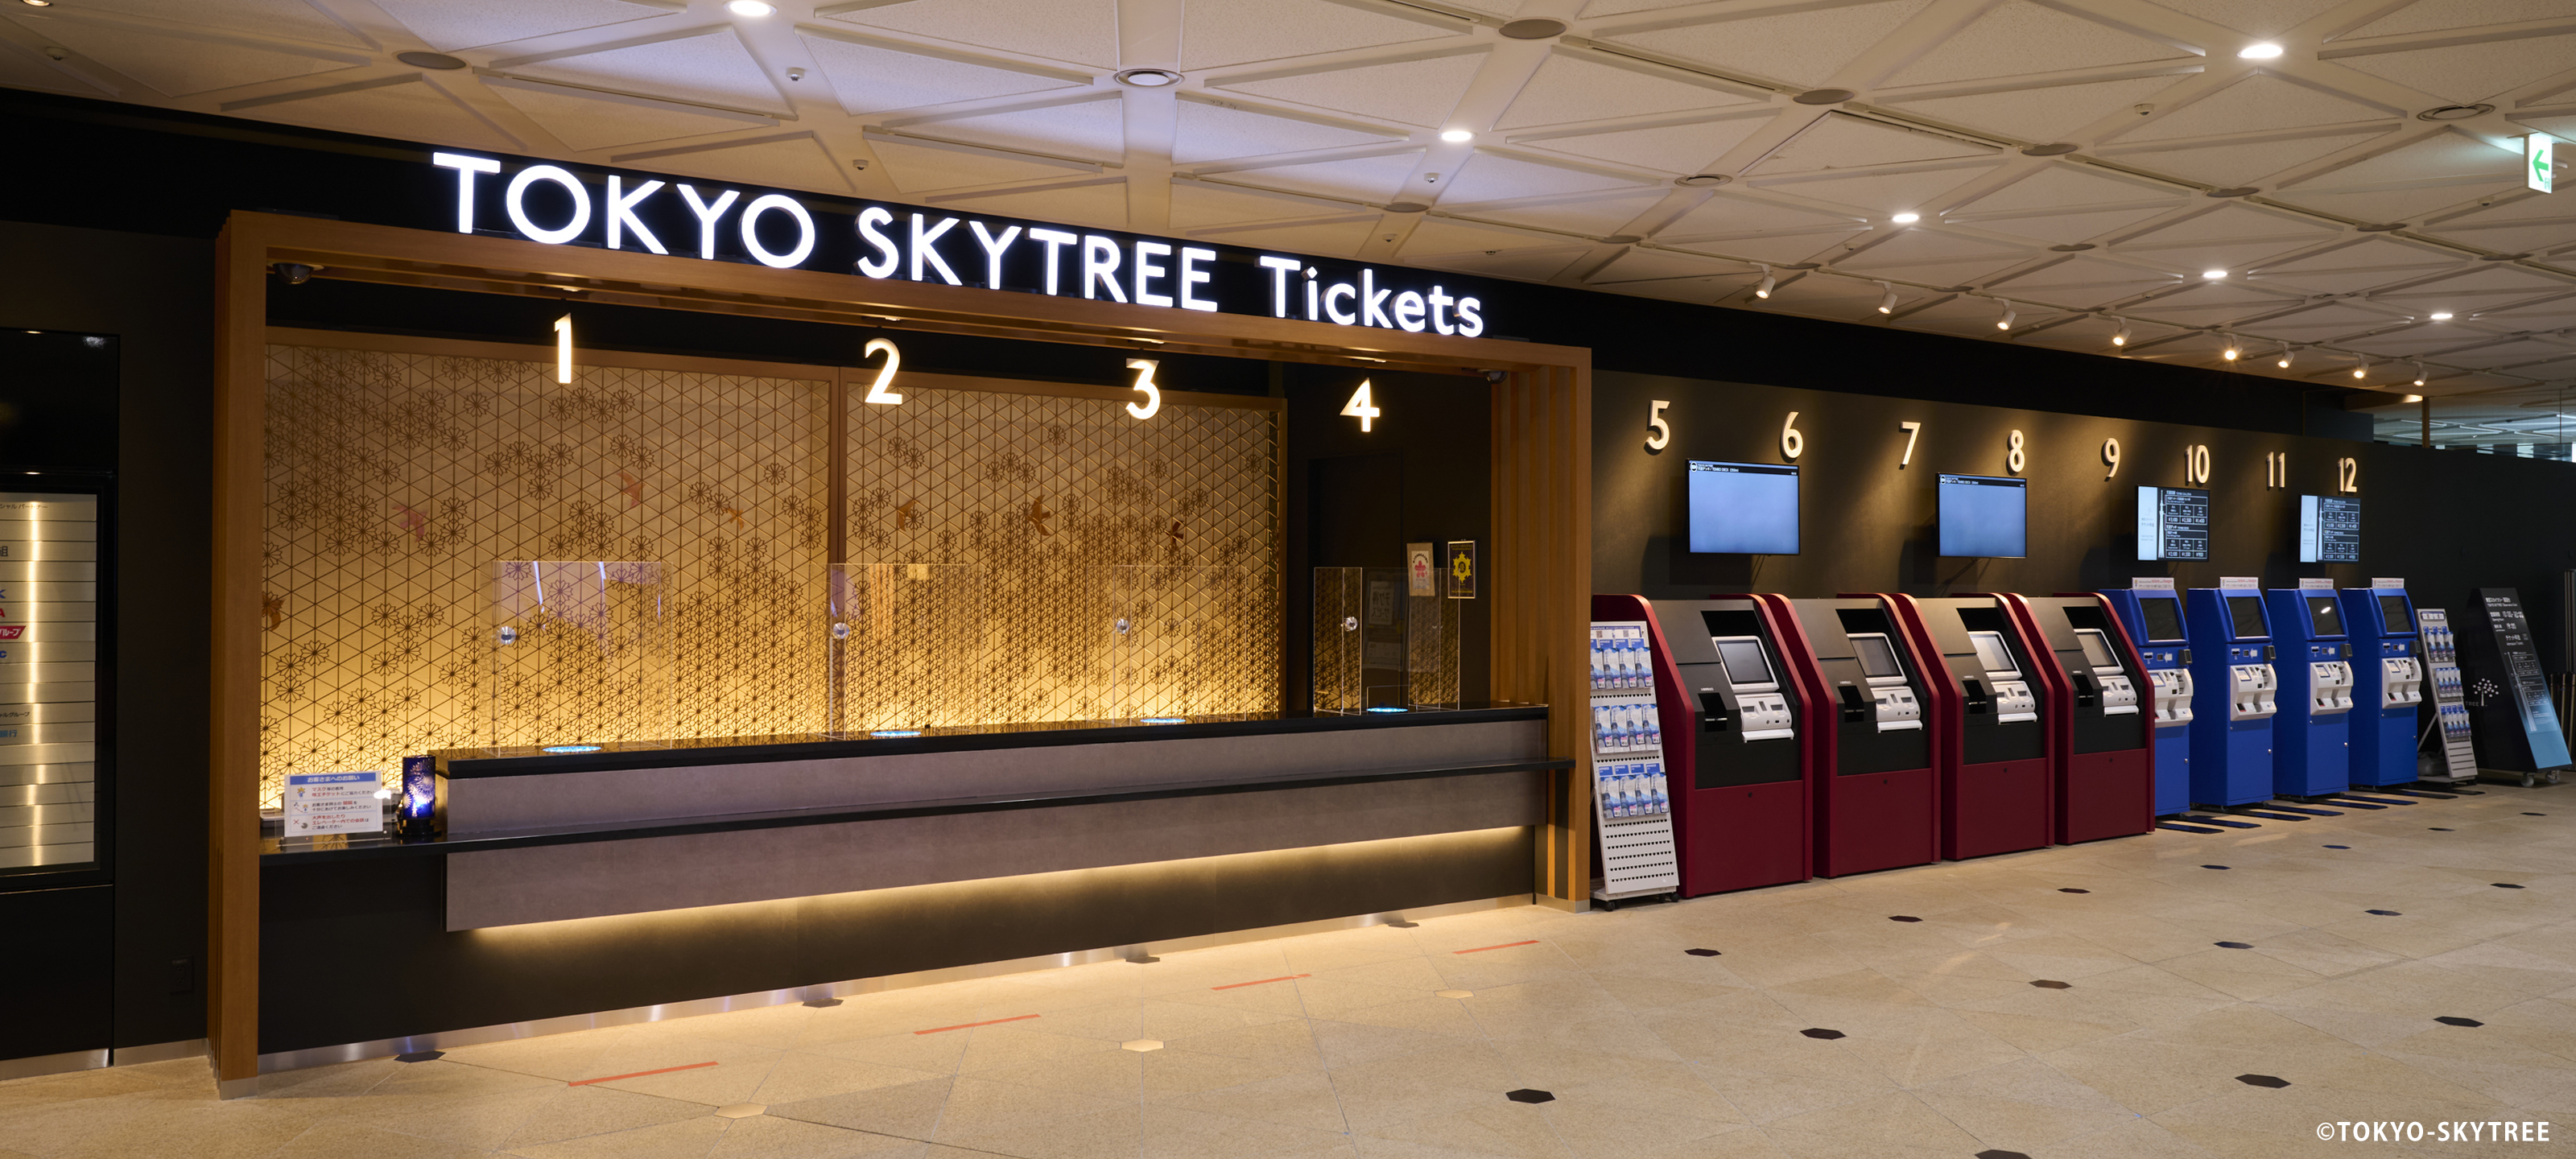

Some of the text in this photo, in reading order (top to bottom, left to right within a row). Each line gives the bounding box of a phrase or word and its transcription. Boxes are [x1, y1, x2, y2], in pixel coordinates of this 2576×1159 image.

[433, 151, 1484, 337] TOKYO SKYTREE Tickets
[554, 312, 572, 384] 1
[864, 337, 902, 404] 2
[1125, 358, 1160, 419] 3
[1340, 377, 1380, 431] 4
[1646, 400, 1670, 449] 5
[1781, 411, 1803, 458] 6
[1901, 422, 1921, 464] 7
[2009, 430, 2025, 472] 8
[2104, 438, 2120, 477] 9
[2186, 445, 2210, 483] 10
[2267, 452, 2285, 487] 11
[2338, 458, 2357, 493] 12
